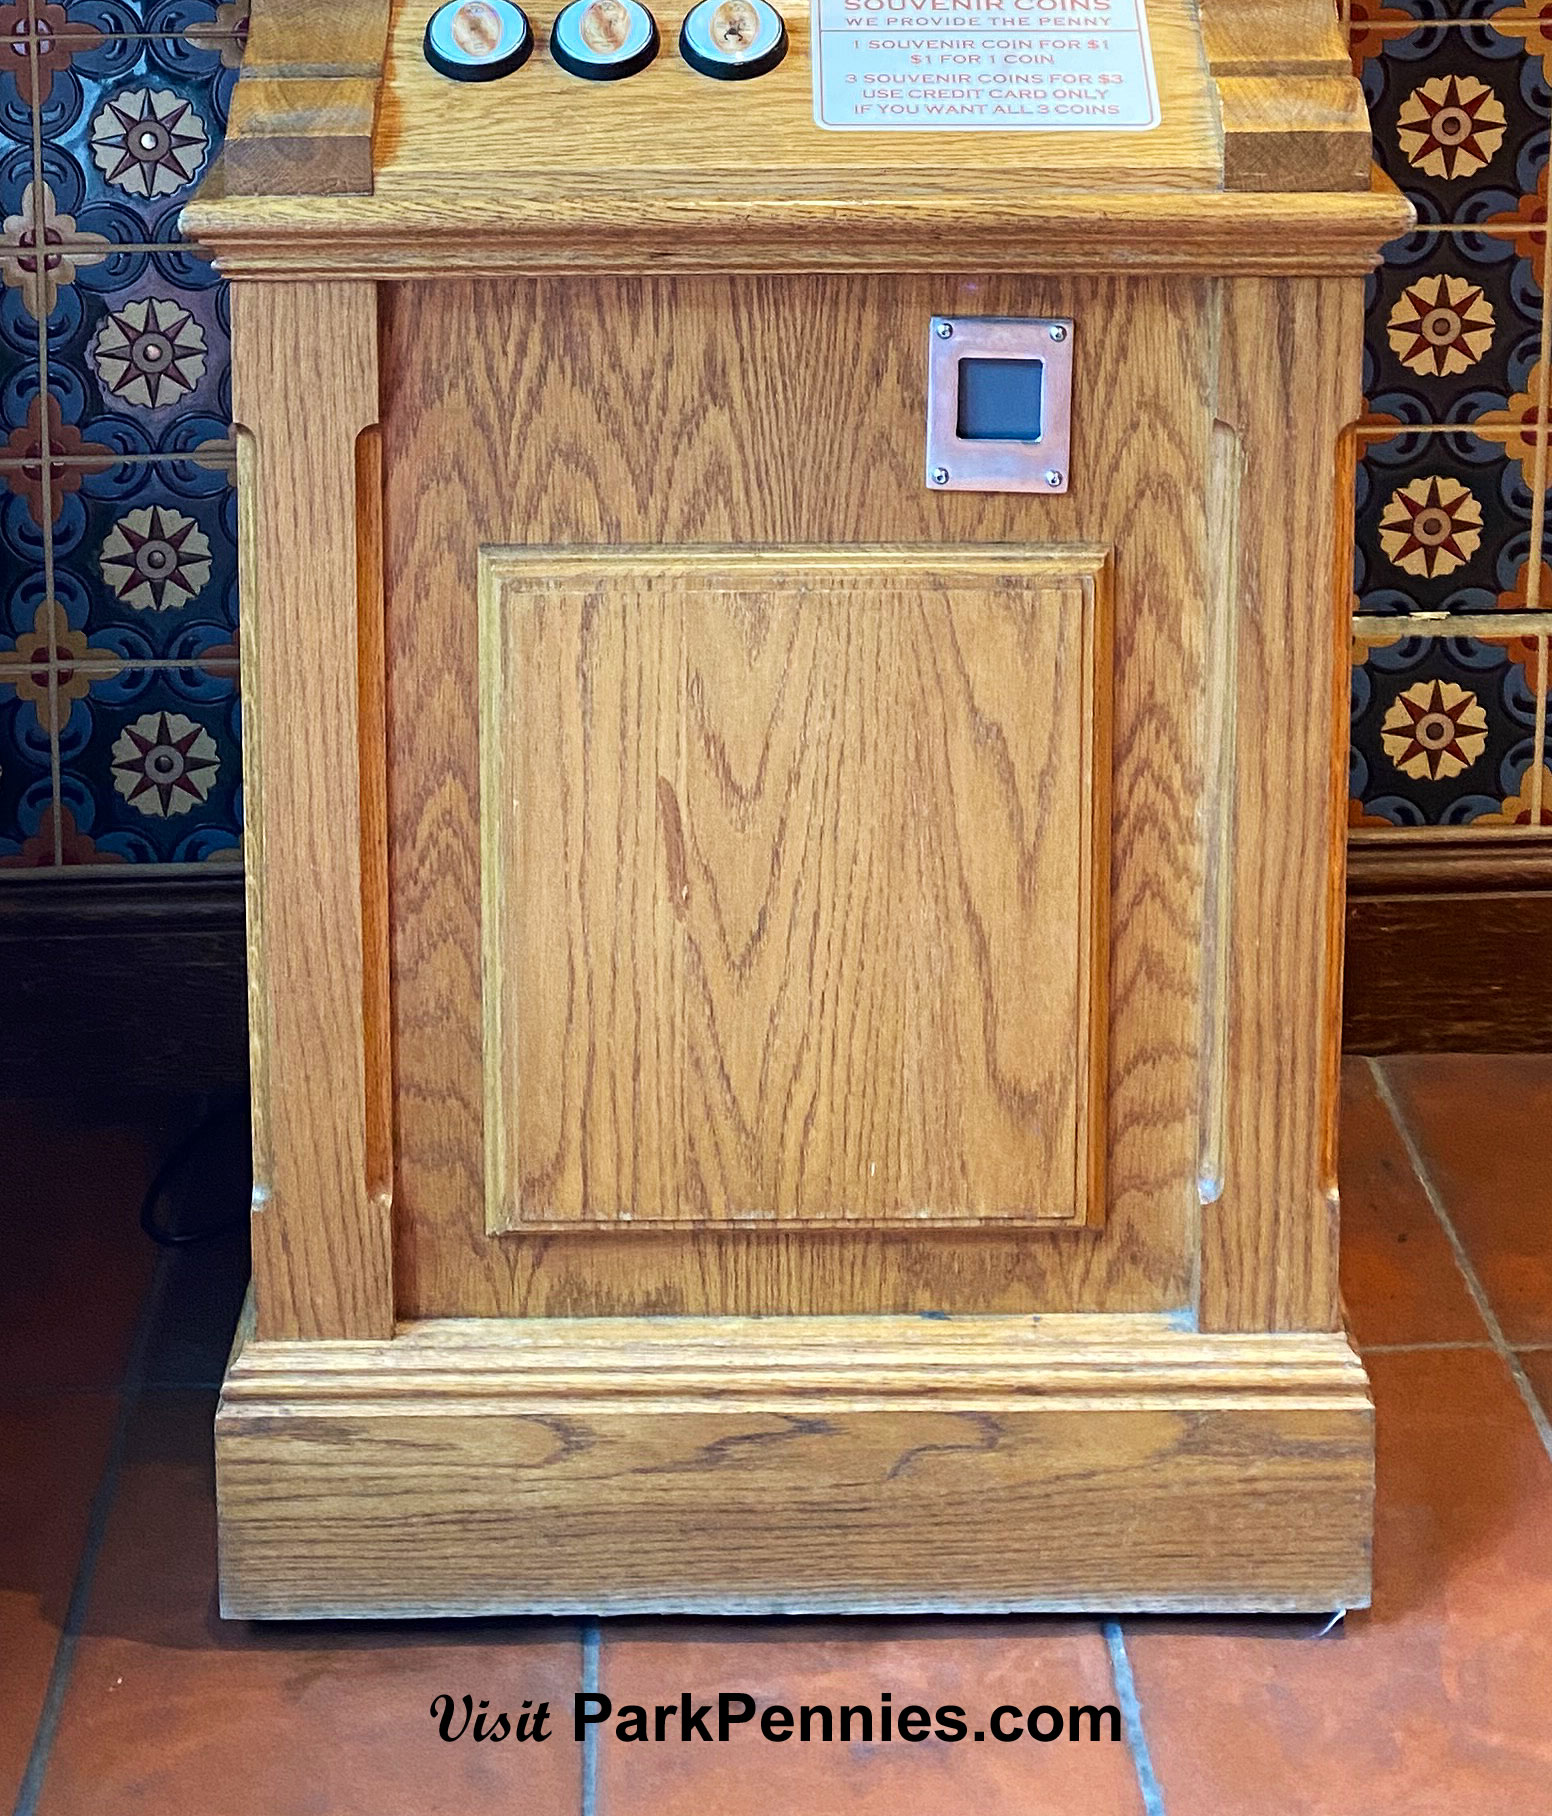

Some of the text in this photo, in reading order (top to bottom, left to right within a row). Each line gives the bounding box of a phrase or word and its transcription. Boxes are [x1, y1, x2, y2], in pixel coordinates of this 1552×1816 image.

[846, 17, 1112, 26] WE PROVIDE THE PENNY
[853, 40, 1109, 50] 1 SOUVENIR COIN FOR $1
[910, 54, 1054, 65] $1 FOR 1 COIN
[845, 74, 1124, 84] 3 SOUVENIR COINS FOR $3
[863, 89, 1109, 100] USE CREDIT CARD ONLY
[854, 104, 1121, 115] IF YOU WANT ALL 3 COINS
